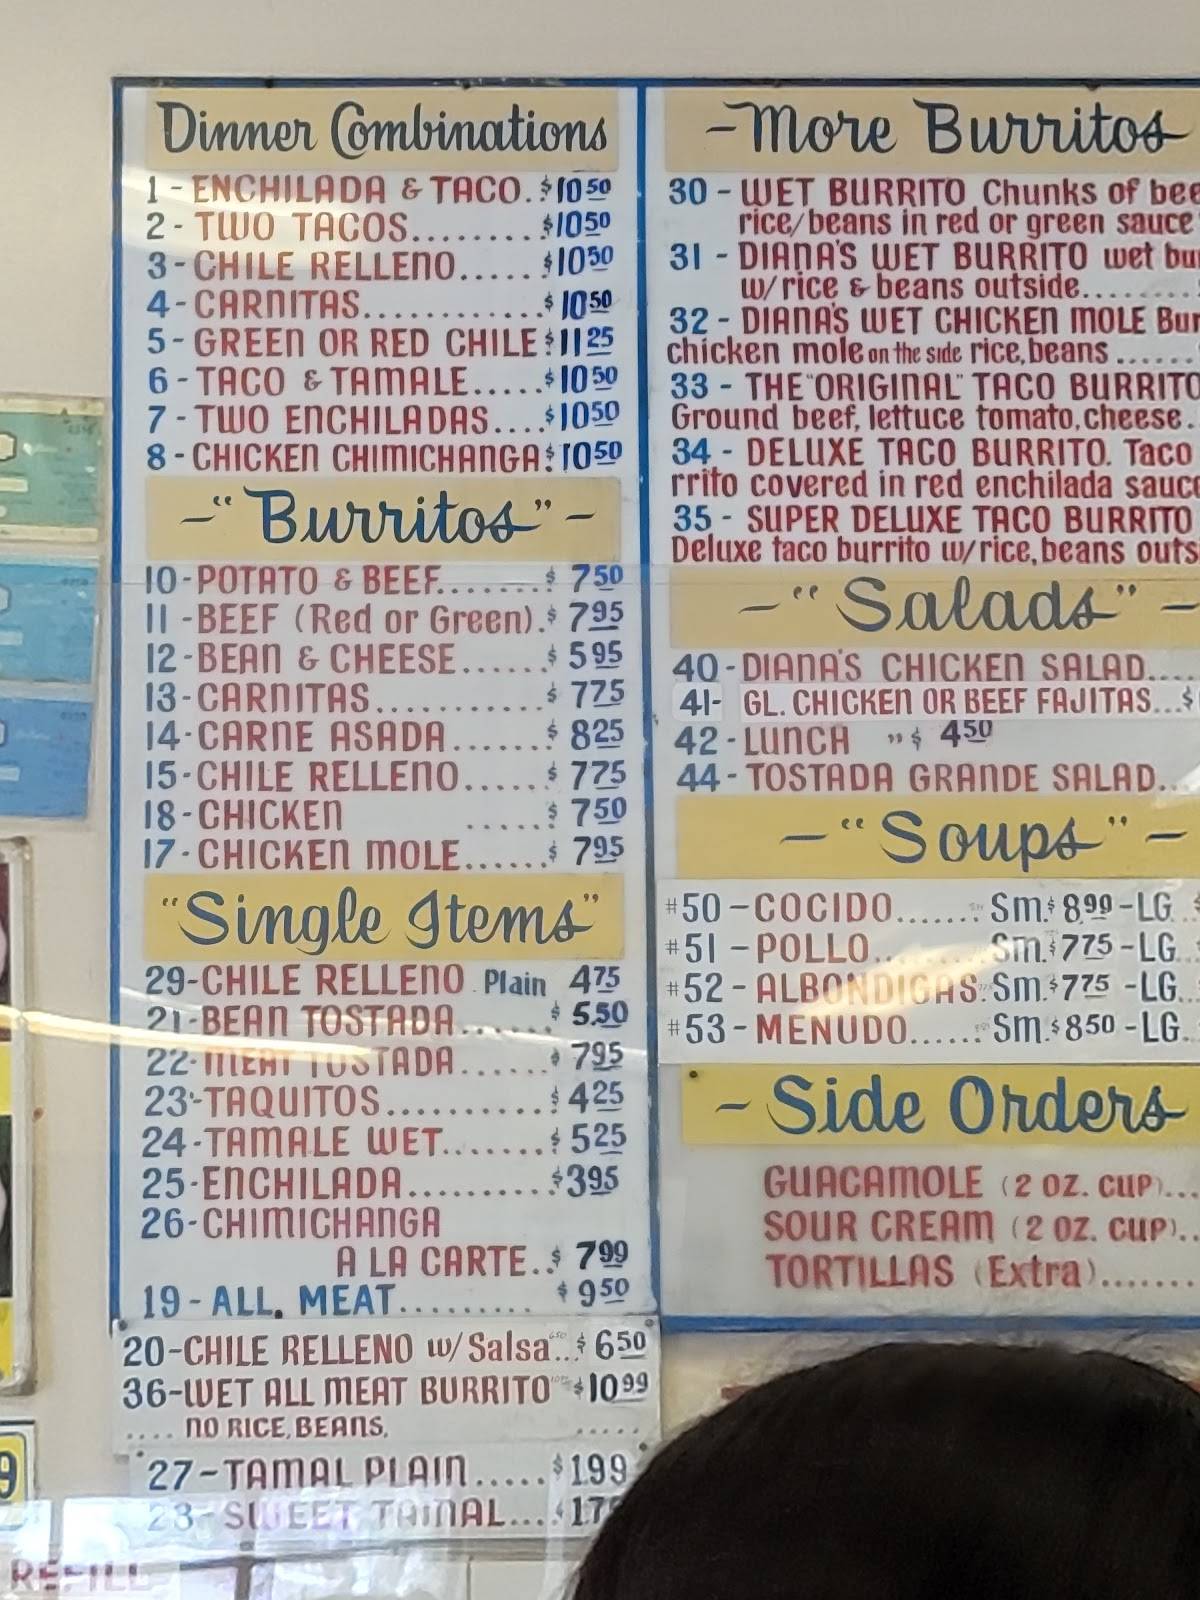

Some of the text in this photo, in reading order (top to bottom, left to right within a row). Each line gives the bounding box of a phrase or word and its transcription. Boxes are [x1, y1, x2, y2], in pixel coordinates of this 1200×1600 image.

[157, 100, 608, 160] Dinner Combinations
[724, 98, 1190, 154] More Burritos
[192, 175, 521, 204] ENCHILADA TACO
[741, 178, 815, 206] WET
[829, 177, 966, 206] BURRITO
[983, 178, 1096, 206] Chunks
[1108, 177, 1140, 206] of
[195, 211, 408, 242] TWO TACOS
[902, 209, 1195, 238] in red or green sauce
[194, 251, 455, 280] CHILE RELLENO
[740, 239, 1153, 271] DIANA'S WET BURRITO wet
[877, 274, 1079, 301] beans outside
[194, 290, 360, 320] CARNITAS
[742, 303, 1147, 335] DIANA'S WET CHICKEN MOLE
[194, 328, 538, 358] GREEN OR RED CHILE
[667, 336, 962, 364] chicken mole on the side
[197, 366, 467, 396] TACO TAMALE
[746, 372, 802, 400] THE
[972, 372, 1055, 400] TACO
[194, 406, 488, 435] TWO ENCHILADAS
[672, 404, 964, 432] Ground beef, lettuce
[193, 443, 539, 473] CHICKEN CHIMICHANGA
[748, 437, 864, 467] DELUXE
[877, 438, 956, 465] TACO
[1123, 439, 1191, 465] Taco
[672, 470, 1112, 499] rrito covered in red enchilada
[748, 505, 839, 534] SUPER
[853, 506, 962, 534] DELUXE
[972, 505, 1050, 533] TACO
[1065, 506, 1191, 534] BURRITO
[672, 535, 930, 564] Deluxe taco burrito
[197, 566, 317, 595] POTATO
[363, 565, 440, 594] BEEF
[197, 604, 279, 634] BEEF
[385, 608, 419, 634] or
[198, 643, 455, 674] BEAN CHEESE
[742, 649, 1146, 682] DIANA'S CHICKEN SALAD
[197, 682, 370, 714] CARNITAS
[744, 687, 1151, 716] GL. CHICKEN OR BEEF FAJITAS
[197, 721, 445, 752] CARNE ASADA
[744, 726, 850, 756] LUNCH
[196, 761, 459, 792] CHILE RELLENO
[747, 763, 1156, 792] TOSTADA GRANDE SALAD
[199, 800, 342, 831] CHICKEN
[198, 839, 460, 870] CHICKEN MOLE
[755, 892, 892, 922] COCIDO
[757, 932, 869, 964] POLLO
[202, 964, 545, 996] CHILE RELLENO Plain
[757, 971, 977, 1004] ALBONDIGAS
[202, 1004, 454, 1038] BEAN TOSTADA
[756, 1013, 907, 1045] MENUDO
[204, 1086, 379, 1117] TAQUITOS
[767, 1074, 1188, 1136] Side Orders
[204, 1127, 442, 1158] TAMALE WET
[203, 1166, 401, 1200] ENCHILADA
[764, 1165, 1089, 1200] GUACAMOLE OZ.
[203, 1206, 440, 1239] CHIMICHANGA
[764, 1210, 1097, 1243] SOUR CREAM OZ.
[337, 1246, 526, 1276] A LA CARTE
[766, 1254, 954, 1289] TORTILLAS
[300, 1284, 396, 1315] MEAT
[184, 1336, 269, 1366] CHILE
[282, 1333, 412, 1366] RELLENO
[184, 1375, 551, 1408] WET ALL MEAT BURRITO
[186, 1416, 219, 1437] NO
[224, 1456, 466, 1488] TAMAL PLAIN
[373, 1498, 505, 1529] TAMAL
